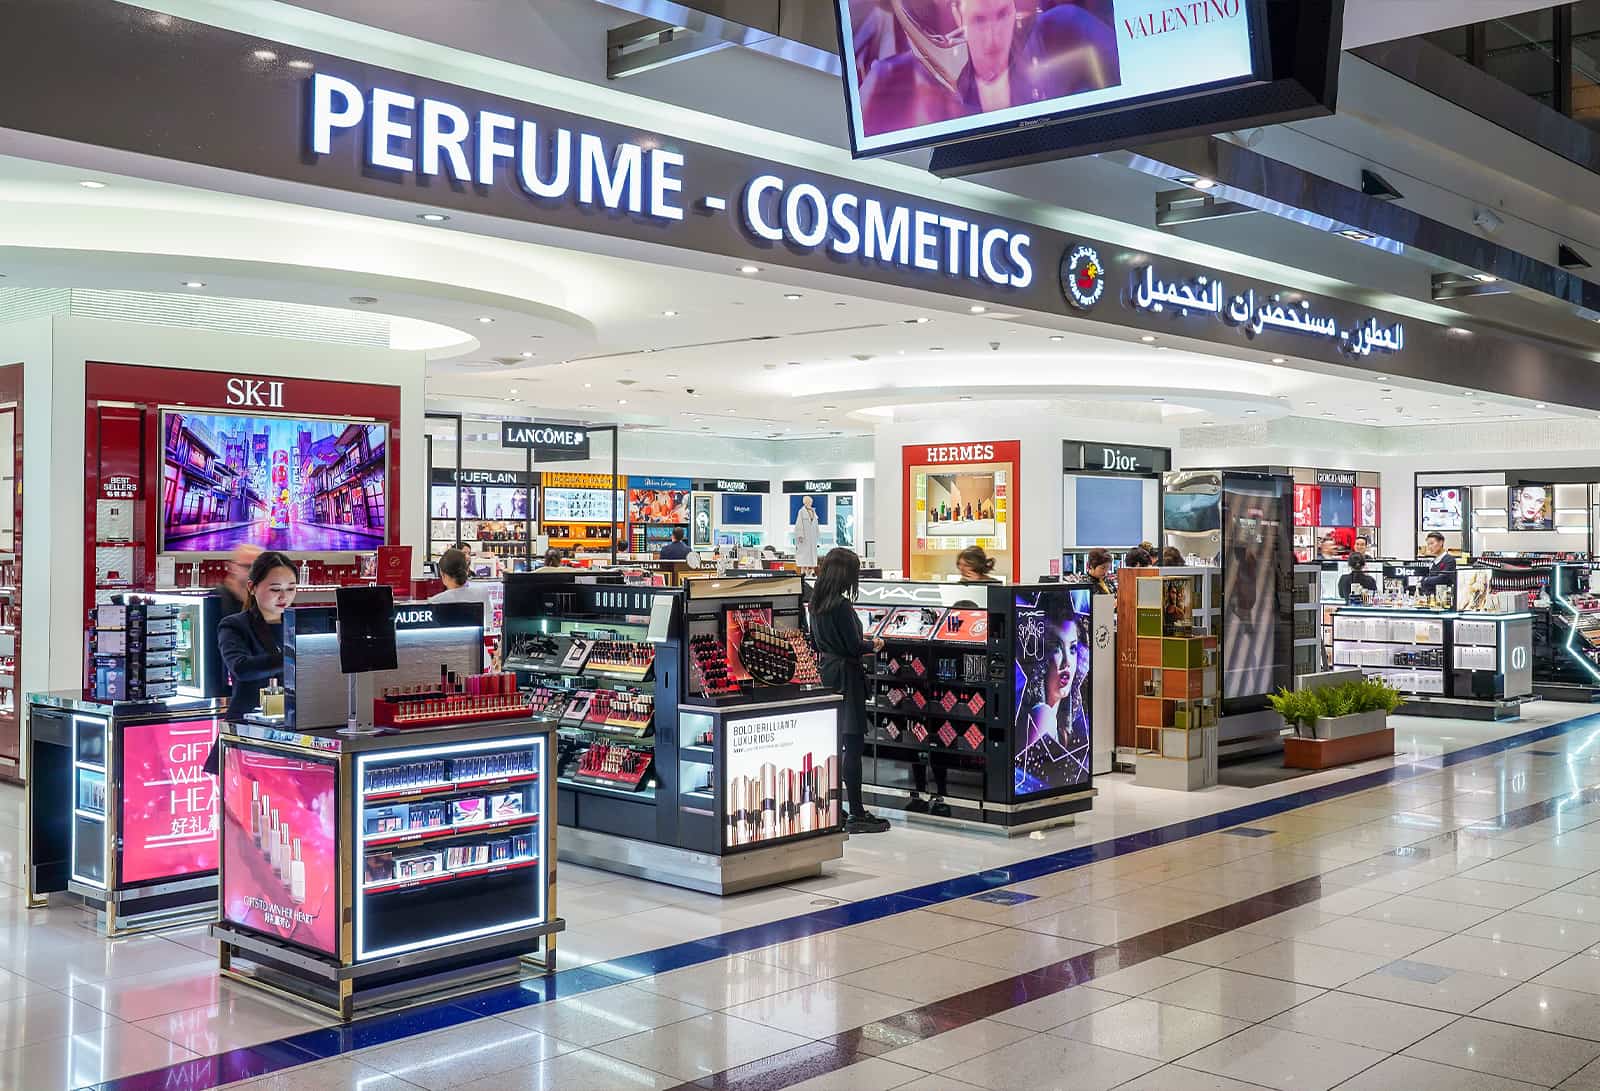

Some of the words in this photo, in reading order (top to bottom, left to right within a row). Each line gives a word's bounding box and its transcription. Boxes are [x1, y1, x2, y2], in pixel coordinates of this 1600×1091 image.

[1124, 0, 1239, 41] VALENTINO
[313, 73, 685, 221] PERFUME
[746, 175, 1034, 289] COSMETICS
[1137, 265, 1224, 317] التجميل
[1230, 290, 1336, 335] مستحضرات
[1353, 316, 1404, 356] العطور
[226, 378, 285, 408] SK-II
[508, 428, 576, 446] LANCÔME
[927, 444, 994, 463] HERMÈS
[103, 483, 137, 491] SELLERS
[394, 610, 433, 624] AUDER
[733, 732, 775, 747] LUXURIOUS
[294, 910, 314, 925] HEART
